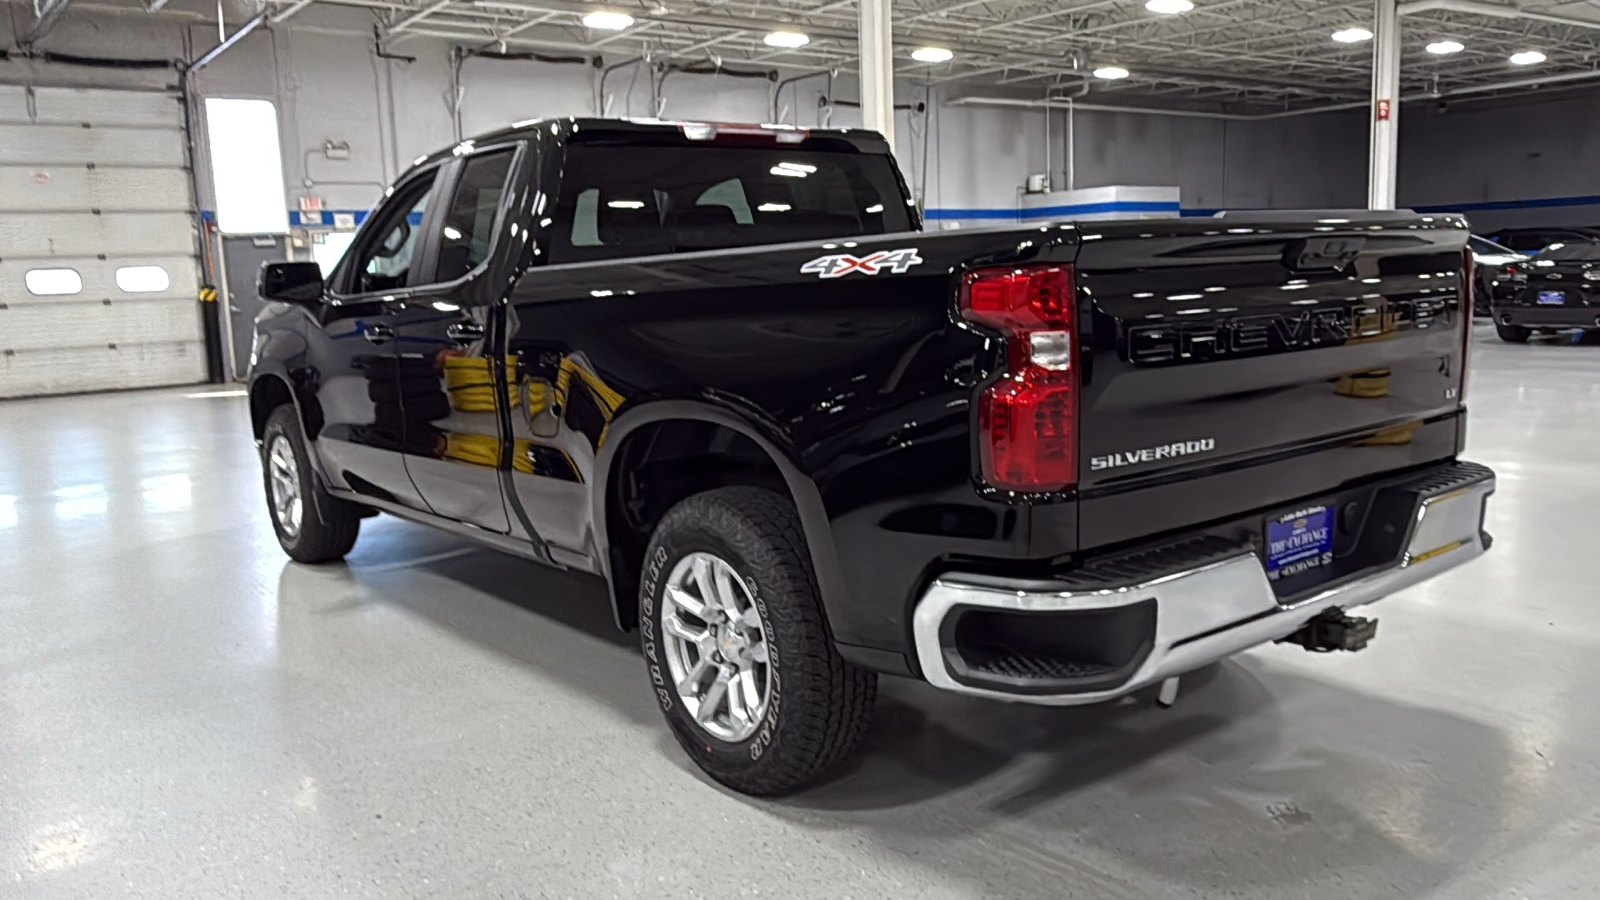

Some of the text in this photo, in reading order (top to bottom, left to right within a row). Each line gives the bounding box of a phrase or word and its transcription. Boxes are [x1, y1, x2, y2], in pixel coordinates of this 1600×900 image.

[1090, 437, 1215, 471] SILVERADO
[642, 546, 673, 711] WRANGLER
[746, 576, 782, 761] GOODYEAR
